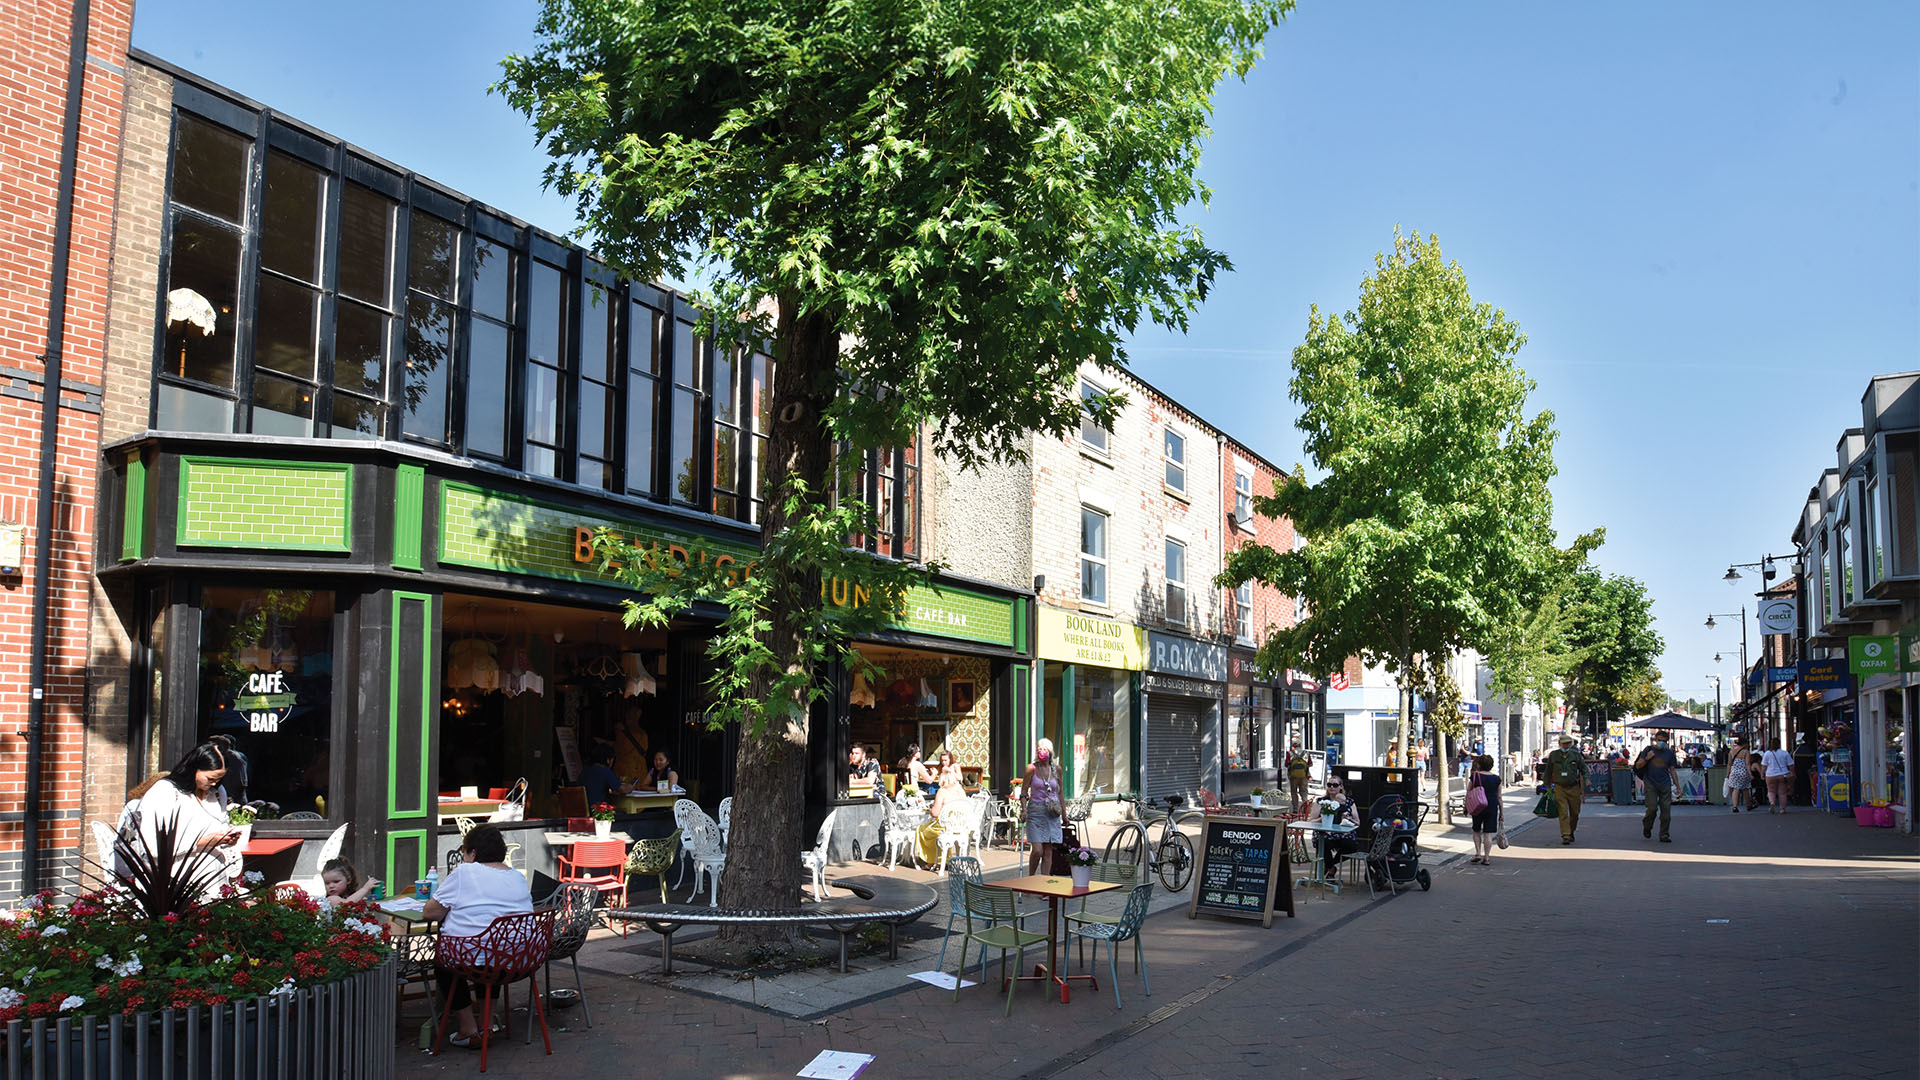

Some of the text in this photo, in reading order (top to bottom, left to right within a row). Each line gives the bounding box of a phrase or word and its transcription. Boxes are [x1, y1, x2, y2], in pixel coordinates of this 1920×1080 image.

[916, 606, 967, 627] CAFÉ BAR
[1066, 615, 1122, 638] BOOK LAND
[1064, 633, 1125, 652] WHERE ALL BOOKS
[1076, 649, 1090, 660] ARE
[1091, 651, 1097, 661] £1
[1098, 653, 1103, 661] &
[1810, 666, 1832, 674] Card
[1860, 660, 1887, 668] OXFAM
[249, 670, 283, 693] CAFÉ
[1147, 675, 1162, 687] GOLD
[1167, 678, 1185, 690] SILVER
[1804, 674, 1839, 682] Factory
[250, 713, 278, 732] BAR
[685, 709, 701, 723] CAFÉ
[1223, 831, 1261, 840] BENDIGO
[1246, 848, 1268, 859] TAPAS
